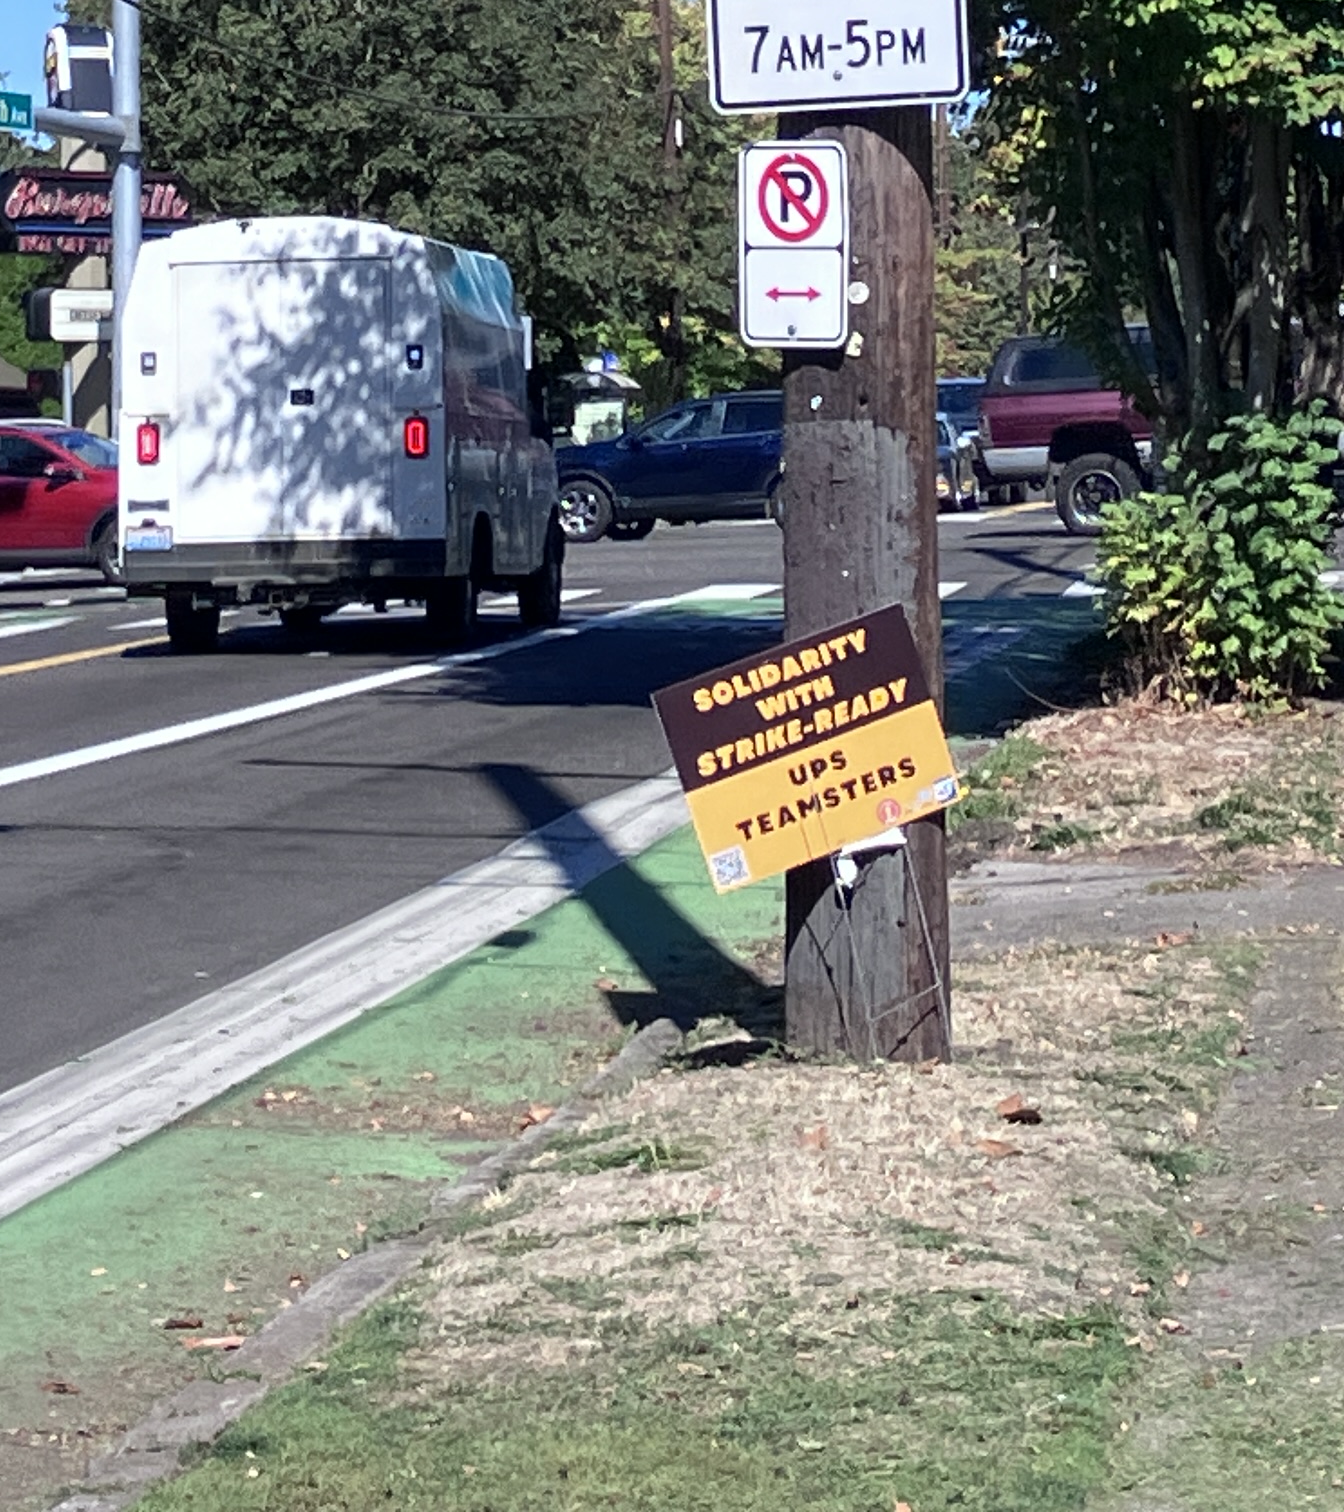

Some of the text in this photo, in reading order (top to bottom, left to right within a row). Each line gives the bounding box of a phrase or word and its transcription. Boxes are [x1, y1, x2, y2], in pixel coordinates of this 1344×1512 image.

[743, 19, 927, 74] 7AM-5PM
[692, 628, 867, 712] SOLIDARITY
[755, 675, 835, 721] WITH
[696, 677, 908, 778] STRIKE-READY
[735, 757, 916, 842] TEAMSTERS
[788, 749, 848, 786] UPS
